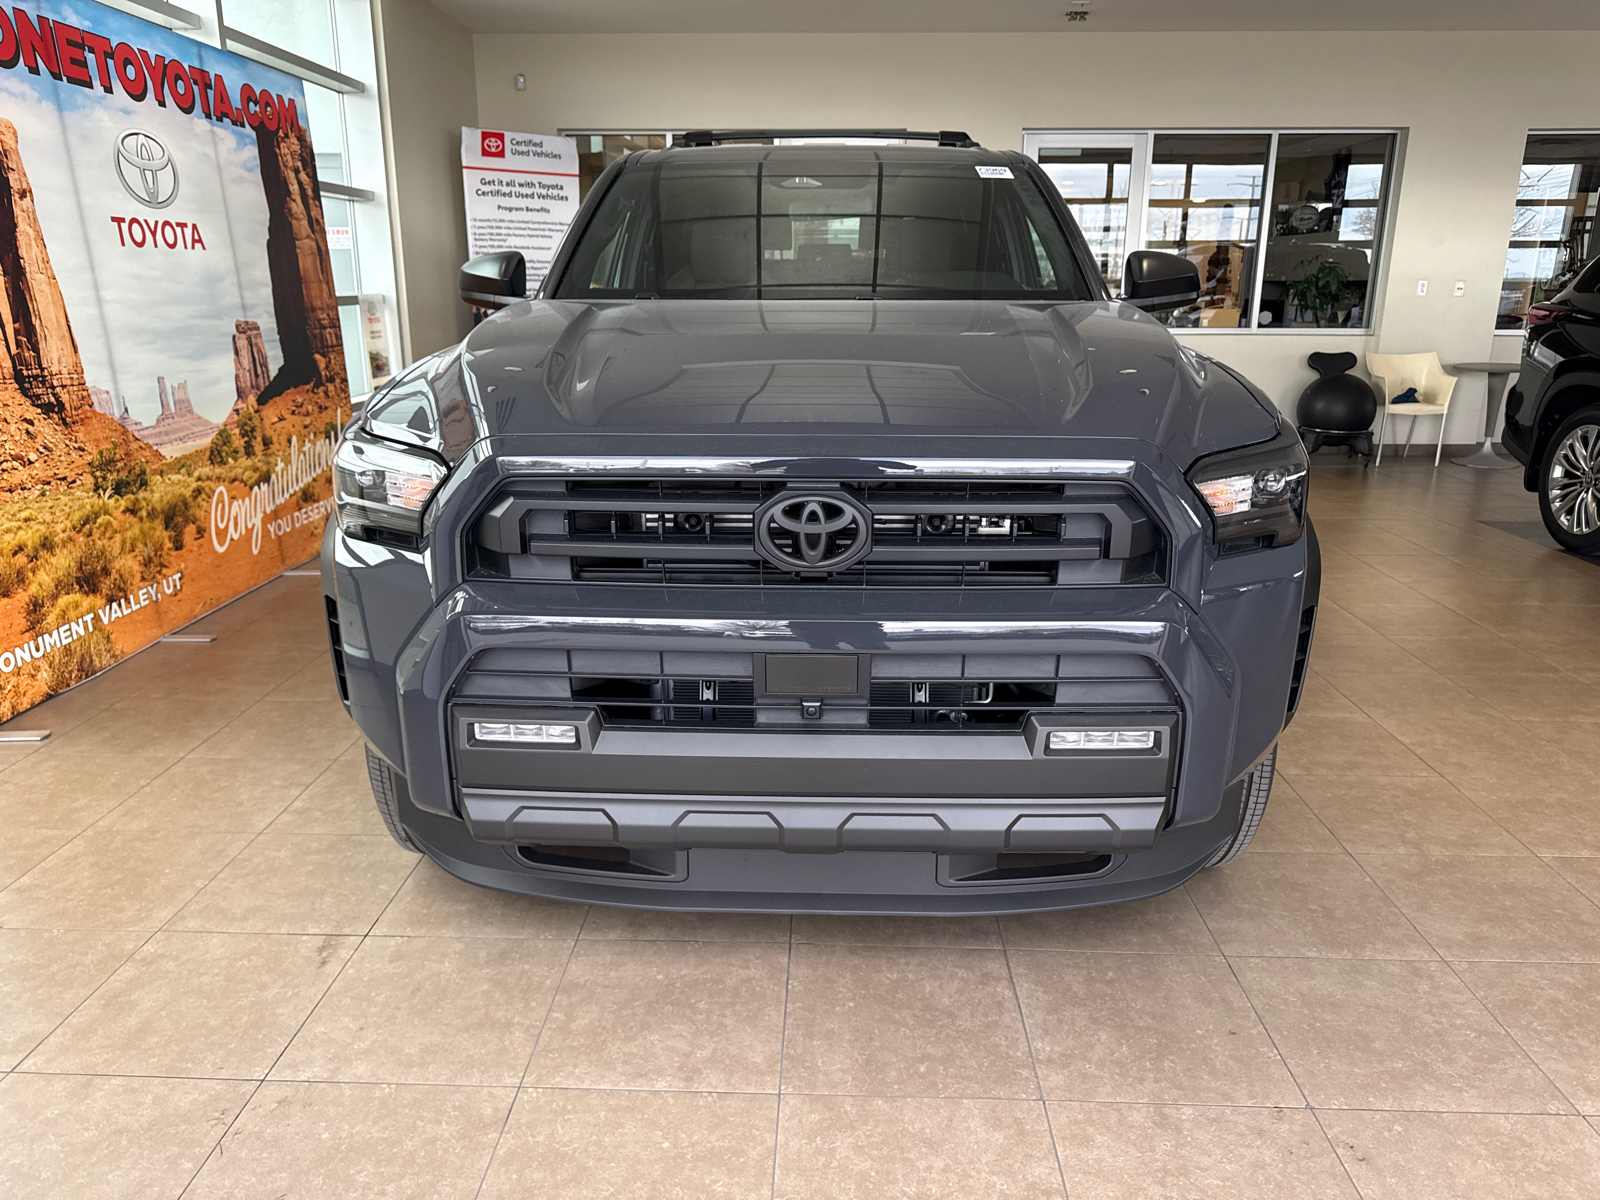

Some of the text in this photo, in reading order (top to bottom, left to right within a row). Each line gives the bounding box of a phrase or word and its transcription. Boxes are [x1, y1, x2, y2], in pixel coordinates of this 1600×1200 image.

[510, 138, 543, 148] Certified
[511, 148, 562, 160] Used Vehicles
[480, 178, 564, 191] Get it all with Toyota
[475, 188, 569, 202] Certified Used Vehicles
[497, 204, 551, 214] Program Benefits
[110, 216, 206, 251] TOYOTA
[267, 516, 292, 539] YOU
[98, 583, 162, 625] VALLEY,
[162, 573, 182, 596] UT
